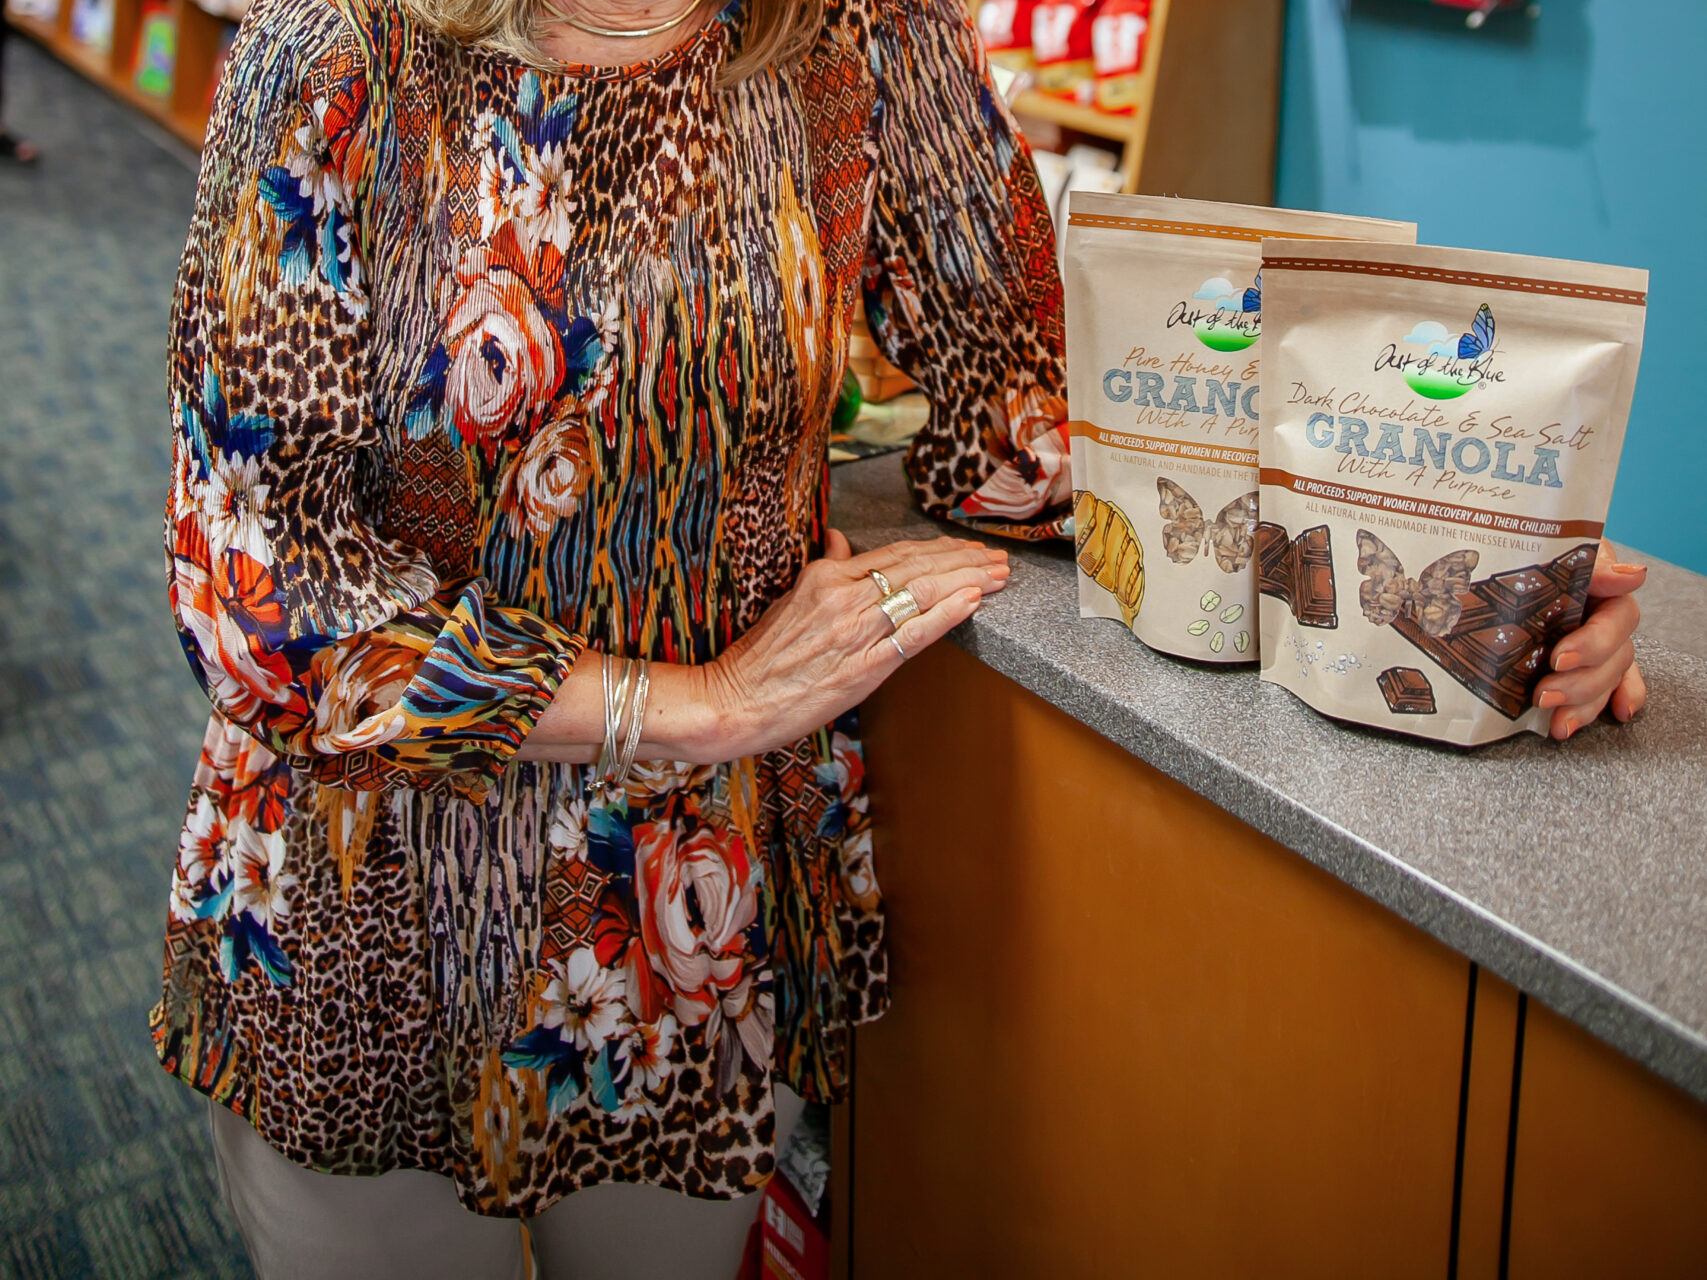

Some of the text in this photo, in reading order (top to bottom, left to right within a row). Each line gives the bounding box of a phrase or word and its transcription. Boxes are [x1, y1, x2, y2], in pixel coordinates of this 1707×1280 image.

[1167, 301, 1207, 328] Out
[1207, 307, 1225, 330] of
[1225, 310, 1248, 330] the
[1123, 346, 1260, 386] Pure Honey &
[1374, 344, 1506, 385] Out of the Blue
[1137, 406, 1191, 429] With
[1200, 414, 1219, 433] A
[1287, 382, 1594, 450] Dark Chocolate & Sea Salt
[1099, 431, 1109, 443] ALL
[1110, 434, 1145, 449] PROCEEDS
[1145, 441, 1179, 454] SUPPORT
[1180, 444, 1211, 458] WOMEN
[1211, 449, 1221, 459] IN
[1306, 412, 1563, 488] GRANOLA
[1110, 452, 1123, 463] ALL
[1124, 454, 1156, 468] NATURAL
[1158, 461, 1174, 471] AND
[1176, 463, 1221, 478] HANDMADE
[1223, 469, 1232, 479] IN
[1233, 471, 1248, 481] THE
[1337, 453, 1516, 501] With A Purpose
[1293, 479, 1562, 535] ALL PROCEEDS SUPPORT WOMEN IN RECOVERY AND THEIR CHILDREN
[1305, 501, 1542, 553] ALL NATURAL AND HANDMADE IN THE TENNESSEE VALLEY
